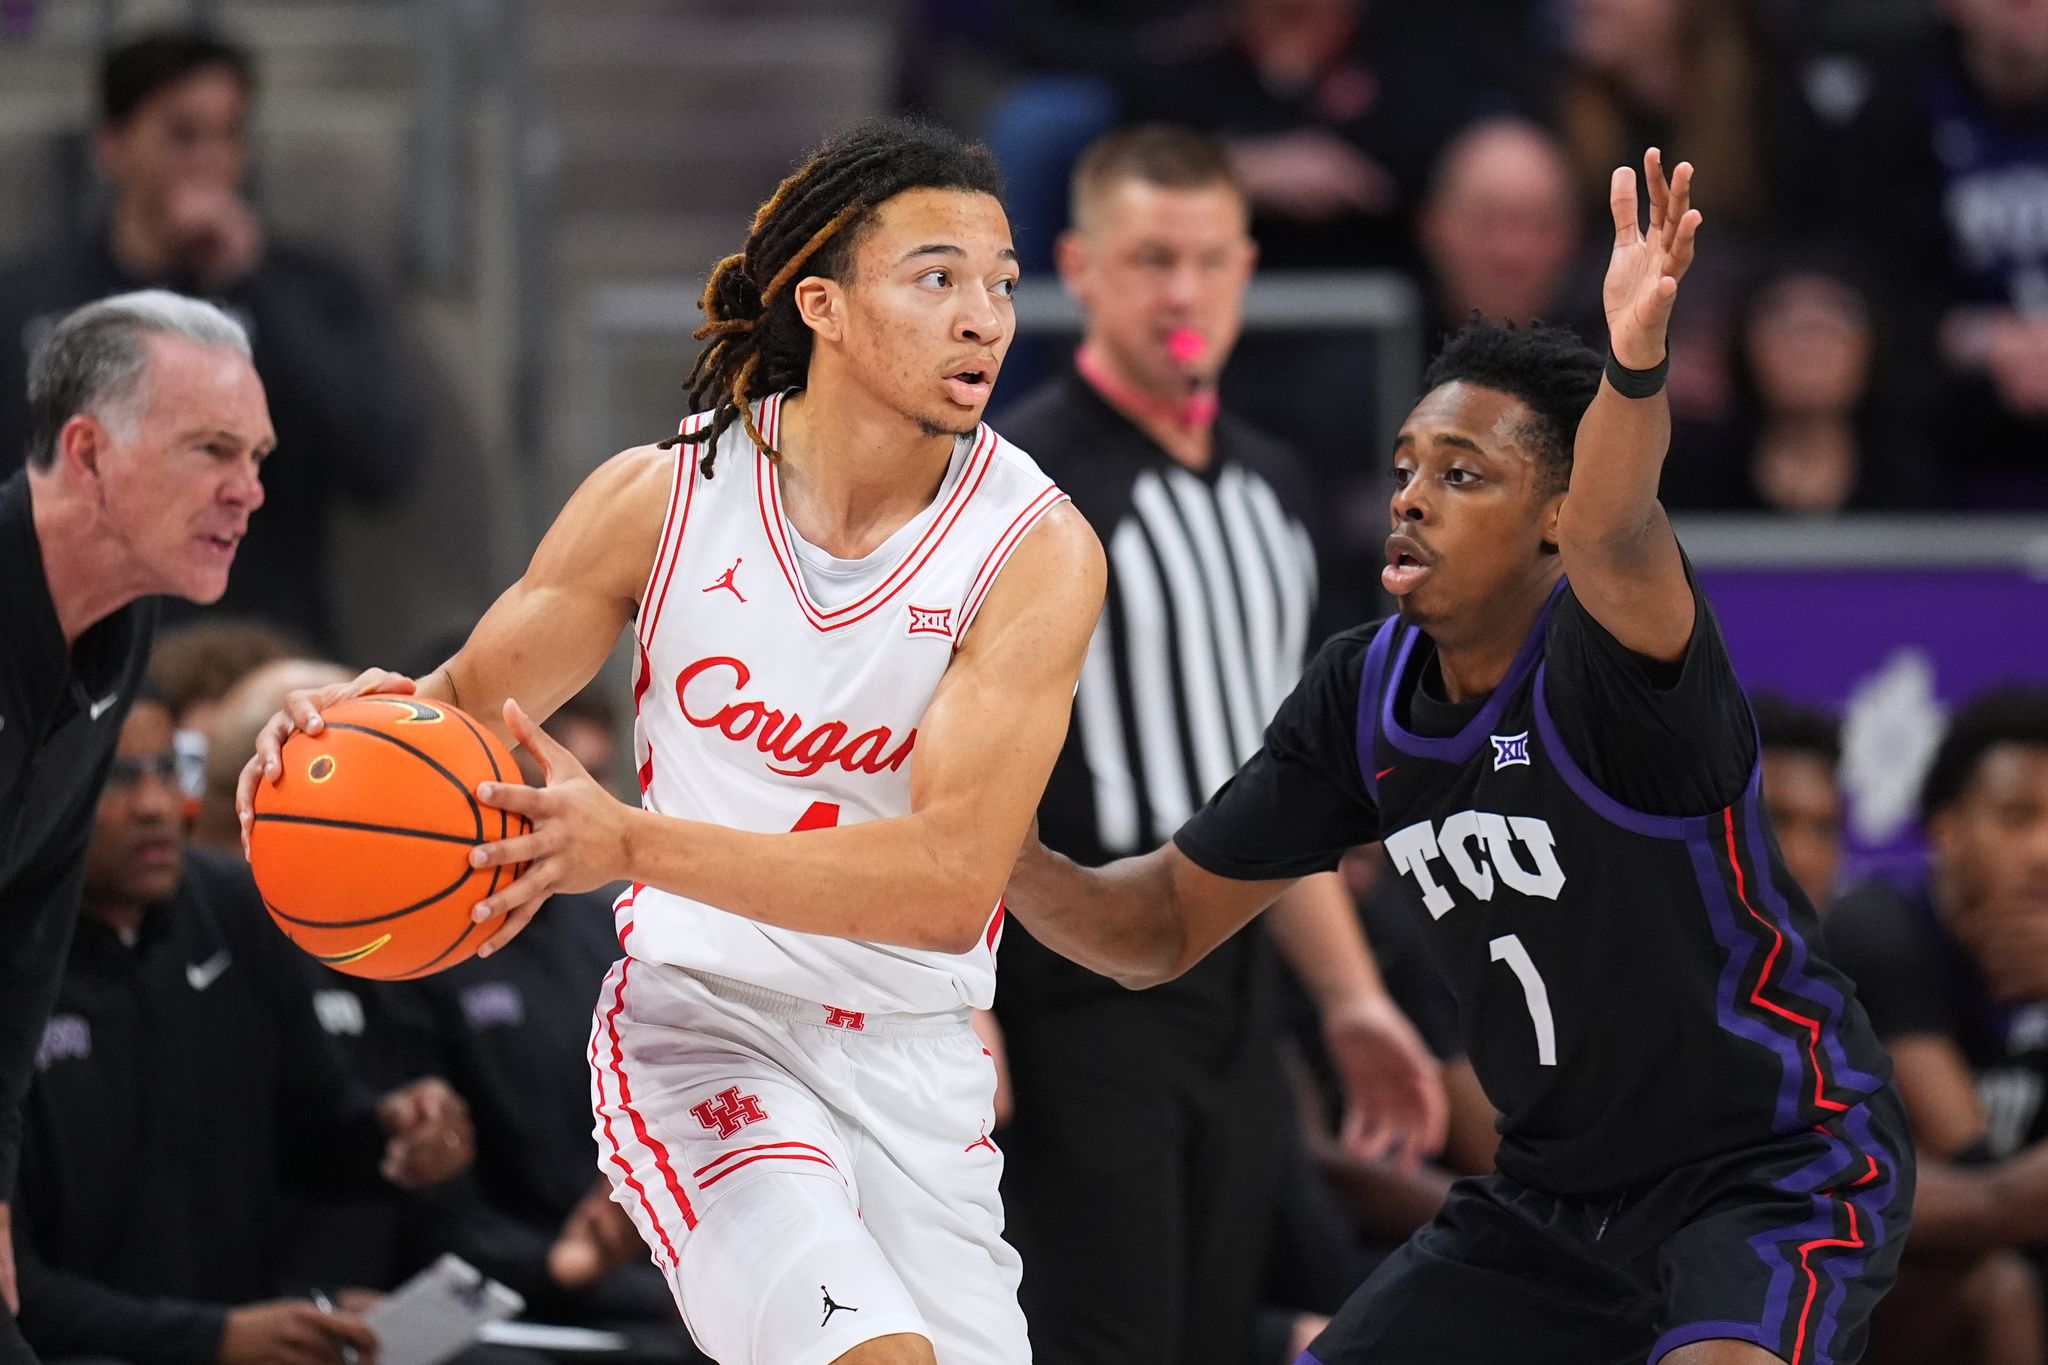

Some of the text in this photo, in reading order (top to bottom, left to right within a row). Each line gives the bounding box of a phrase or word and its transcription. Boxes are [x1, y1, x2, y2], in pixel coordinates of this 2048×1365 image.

[1493, 735, 1529, 767] XII
[1384, 810, 1566, 921] TCU
[1489, 934, 1557, 1065] 1
[690, 1086, 768, 1140] UH
